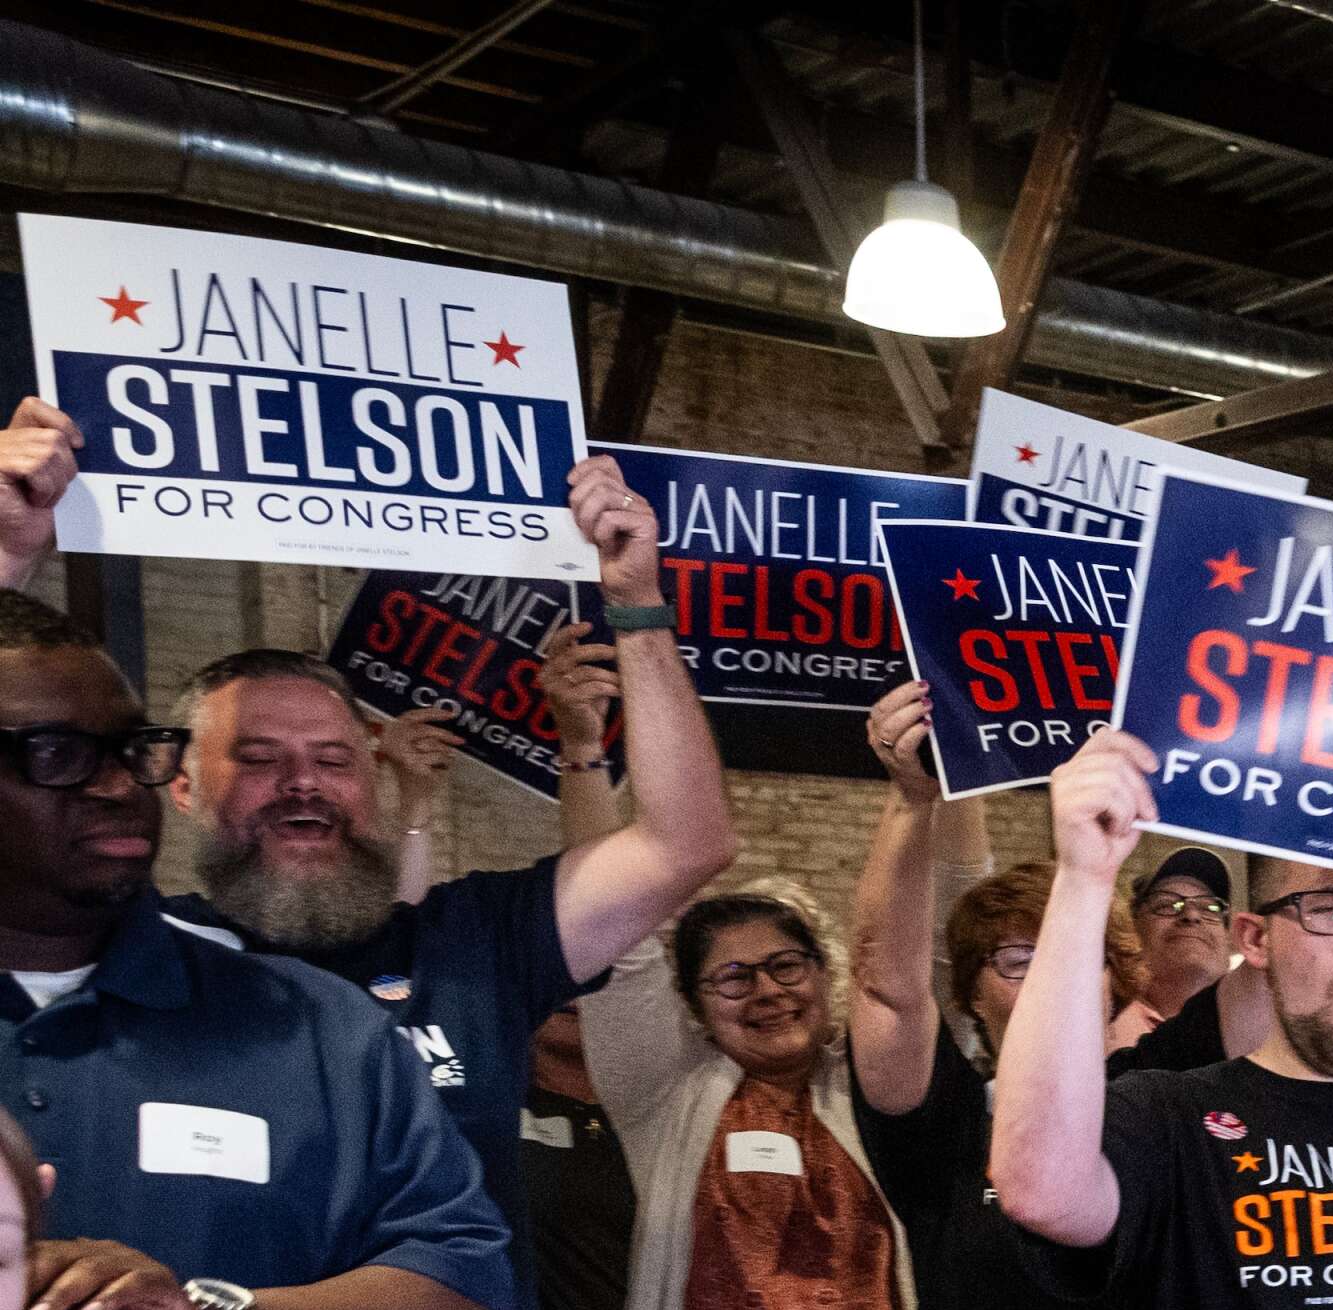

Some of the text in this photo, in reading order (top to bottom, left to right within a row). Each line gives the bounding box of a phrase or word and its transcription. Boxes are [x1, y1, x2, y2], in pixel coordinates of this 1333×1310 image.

[160, 268, 484, 387] JANELLE
[107, 364, 544, 498] STELSON
[1040, 437, 1154, 514] JANE
[117, 484, 550, 542] FOR CONGRESS
[663, 557, 903, 652] TELSO
[991, 554, 1140, 629] JANE
[348, 651, 411, 696] FOR
[712, 646, 904, 683] CONGRE
[977, 719, 1075, 753] FOR
[1162, 748, 1282, 806] FOR
[1239, 1265, 1313, 1289] FOR
